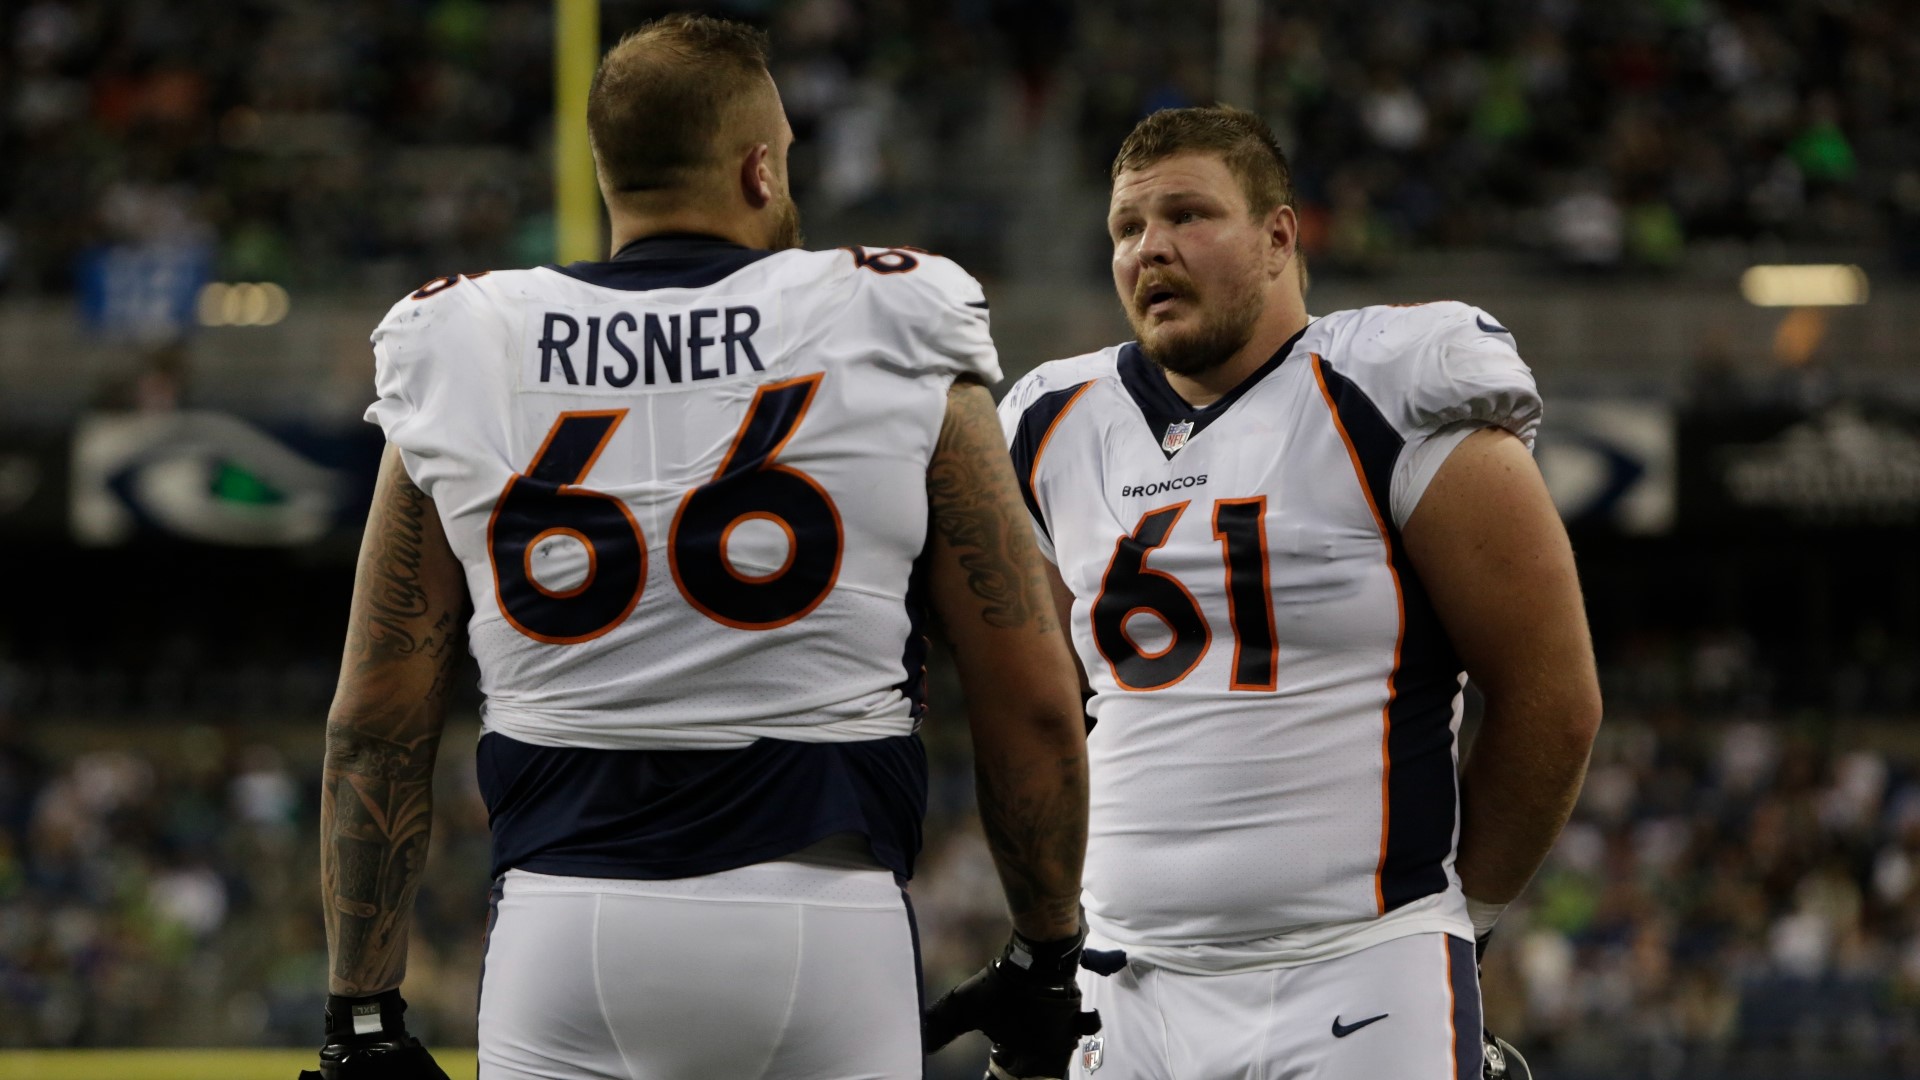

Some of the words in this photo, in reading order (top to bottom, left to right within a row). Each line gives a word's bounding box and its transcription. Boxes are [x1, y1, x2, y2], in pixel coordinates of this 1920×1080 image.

[538, 305, 764, 388] RISNER
[1166, 433, 1184, 447] NFL
[487, 371, 844, 645] 66
[1122, 474, 1208, 498] BRONCOS
[1090, 495, 1279, 692] 61
[1083, 1052, 1098, 1067] NFL
